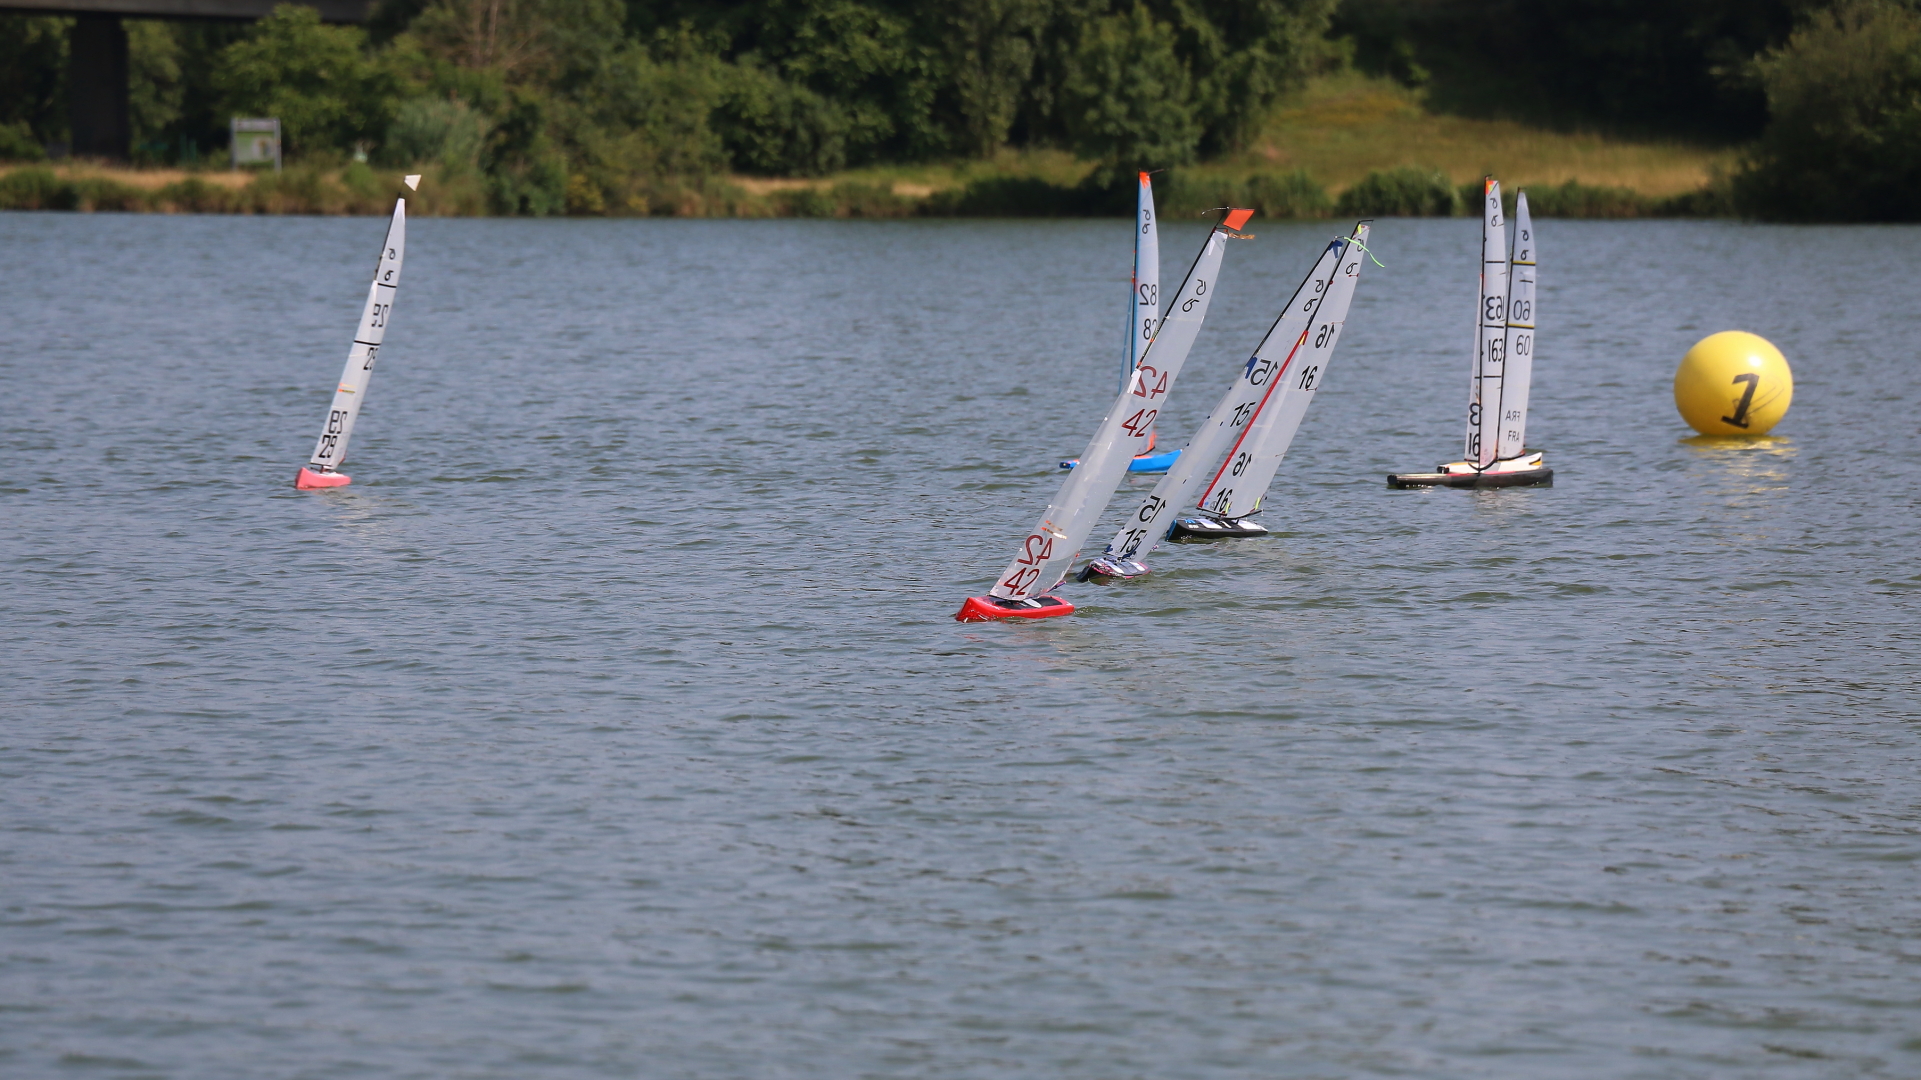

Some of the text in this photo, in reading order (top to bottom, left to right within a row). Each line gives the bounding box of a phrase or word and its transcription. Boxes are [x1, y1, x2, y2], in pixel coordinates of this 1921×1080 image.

[1488, 338, 1504, 362] 163
[1516, 334, 1531, 356] 60
[1299, 365, 1318, 389] 16
[1721, 373, 1760, 429] 1
[1121, 408, 1157, 437] 42
[1230, 401, 1256, 427] 15
[318, 434, 338, 458] 29
[1507, 430, 1520, 442] FRA
[1213, 487, 1233, 512] 16
[1119, 527, 1147, 553] 15
[1003, 567, 1040, 596] 42
